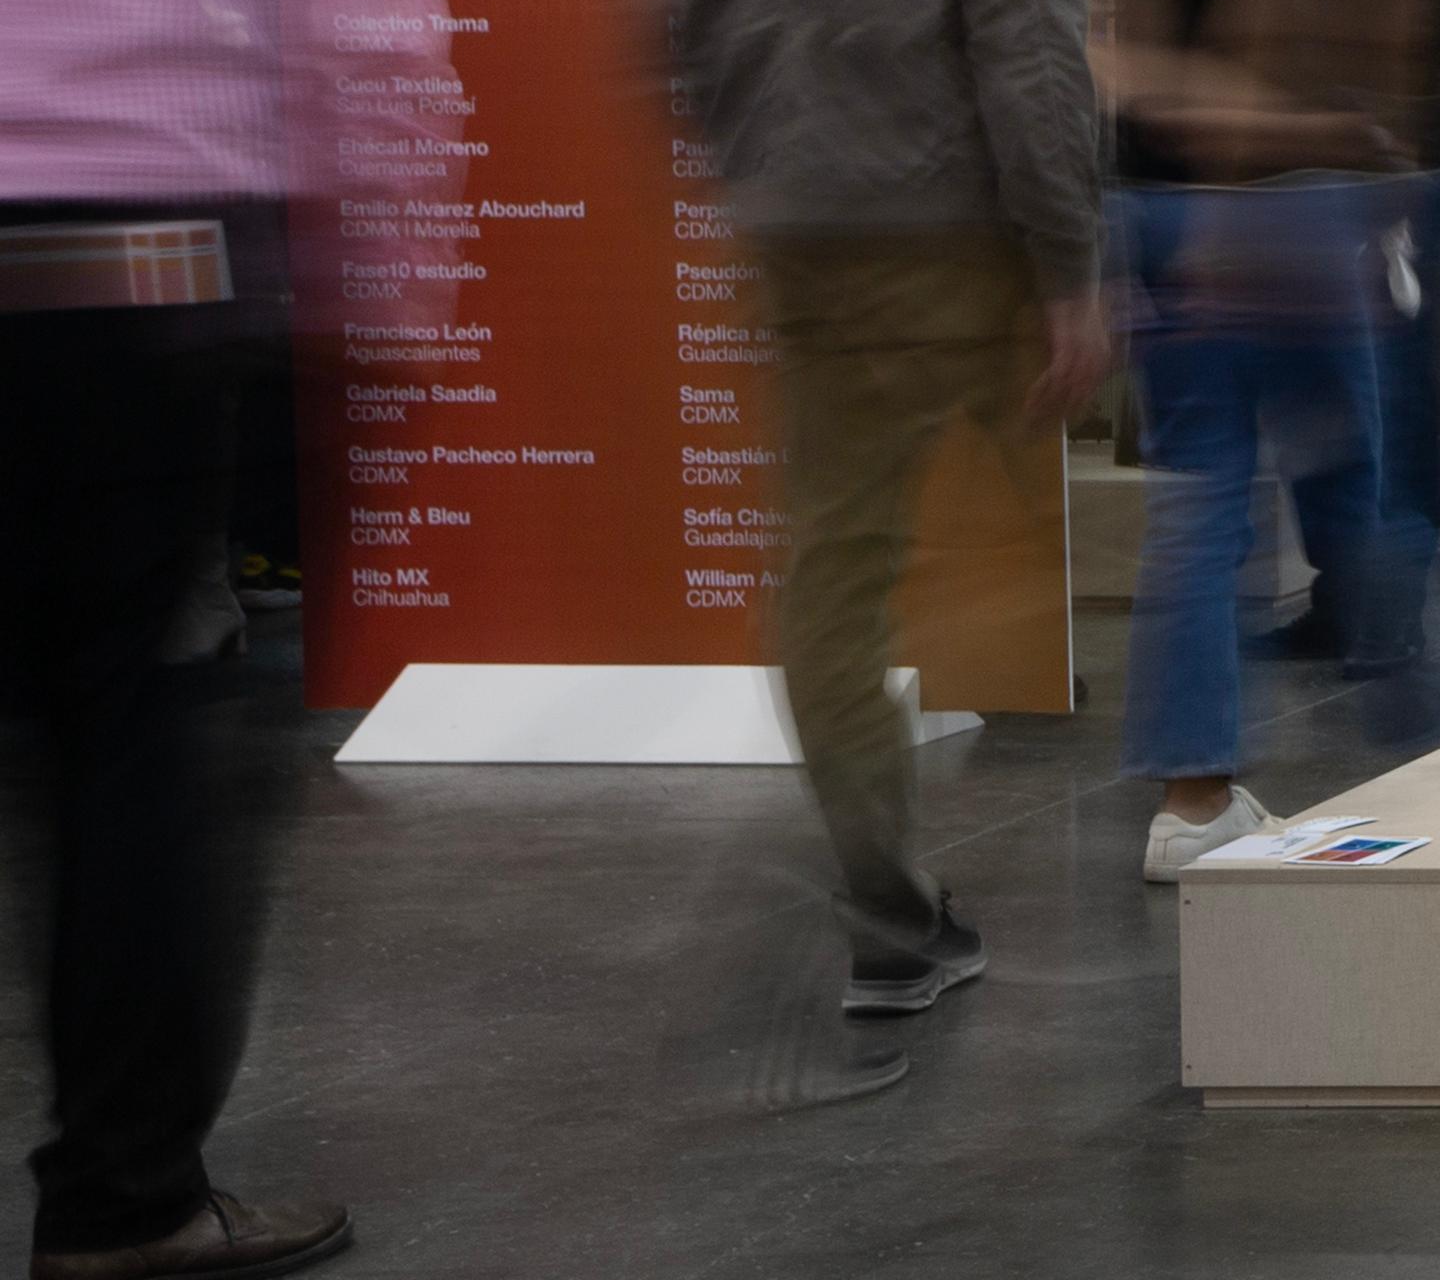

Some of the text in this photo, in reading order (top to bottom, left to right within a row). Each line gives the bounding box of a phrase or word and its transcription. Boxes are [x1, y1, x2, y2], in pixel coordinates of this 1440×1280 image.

[334, 15, 488, 32] Colectivo Trama
[336, 77, 463, 94] Cucu Textiles
[419, 97, 476, 115] Potosí
[415, 139, 489, 156] Moreno
[340, 200, 585, 217] Emilio Alvarez Abouchard
[341, 222, 398, 238] CDMX
[415, 222, 480, 238] Morelia
[675, 222, 733, 239] CDMX
[416, 262, 486, 279] estudio
[344, 283, 401, 299] CDMX
[677, 284, 735, 301] CDMX
[345, 322, 492, 340] Francisco León
[678, 324, 749, 344] Réplica
[345, 345, 480, 365] Aguascalientes
[347, 385, 496, 402] Gabriela Saadia
[680, 386, 734, 403] Sama
[347, 406, 406, 422] CDMX
[681, 407, 739, 424] CDMX
[349, 447, 594, 464] Gustavo Pacheco Herrera
[682, 447, 775, 464] Sebastián
[350, 467, 408, 484] CDMX
[683, 468, 741, 485] CDMX
[351, 508, 470, 525] Herm & Bleu
[683, 509, 732, 526] Sofía
[352, 528, 410, 545] CDMX
[685, 530, 791, 549] Guadalajara
[353, 569, 429, 586] Hito MX
[686, 570, 754, 587] William
[353, 589, 449, 606] Chihuahua
[687, 590, 745, 607] CDMX
